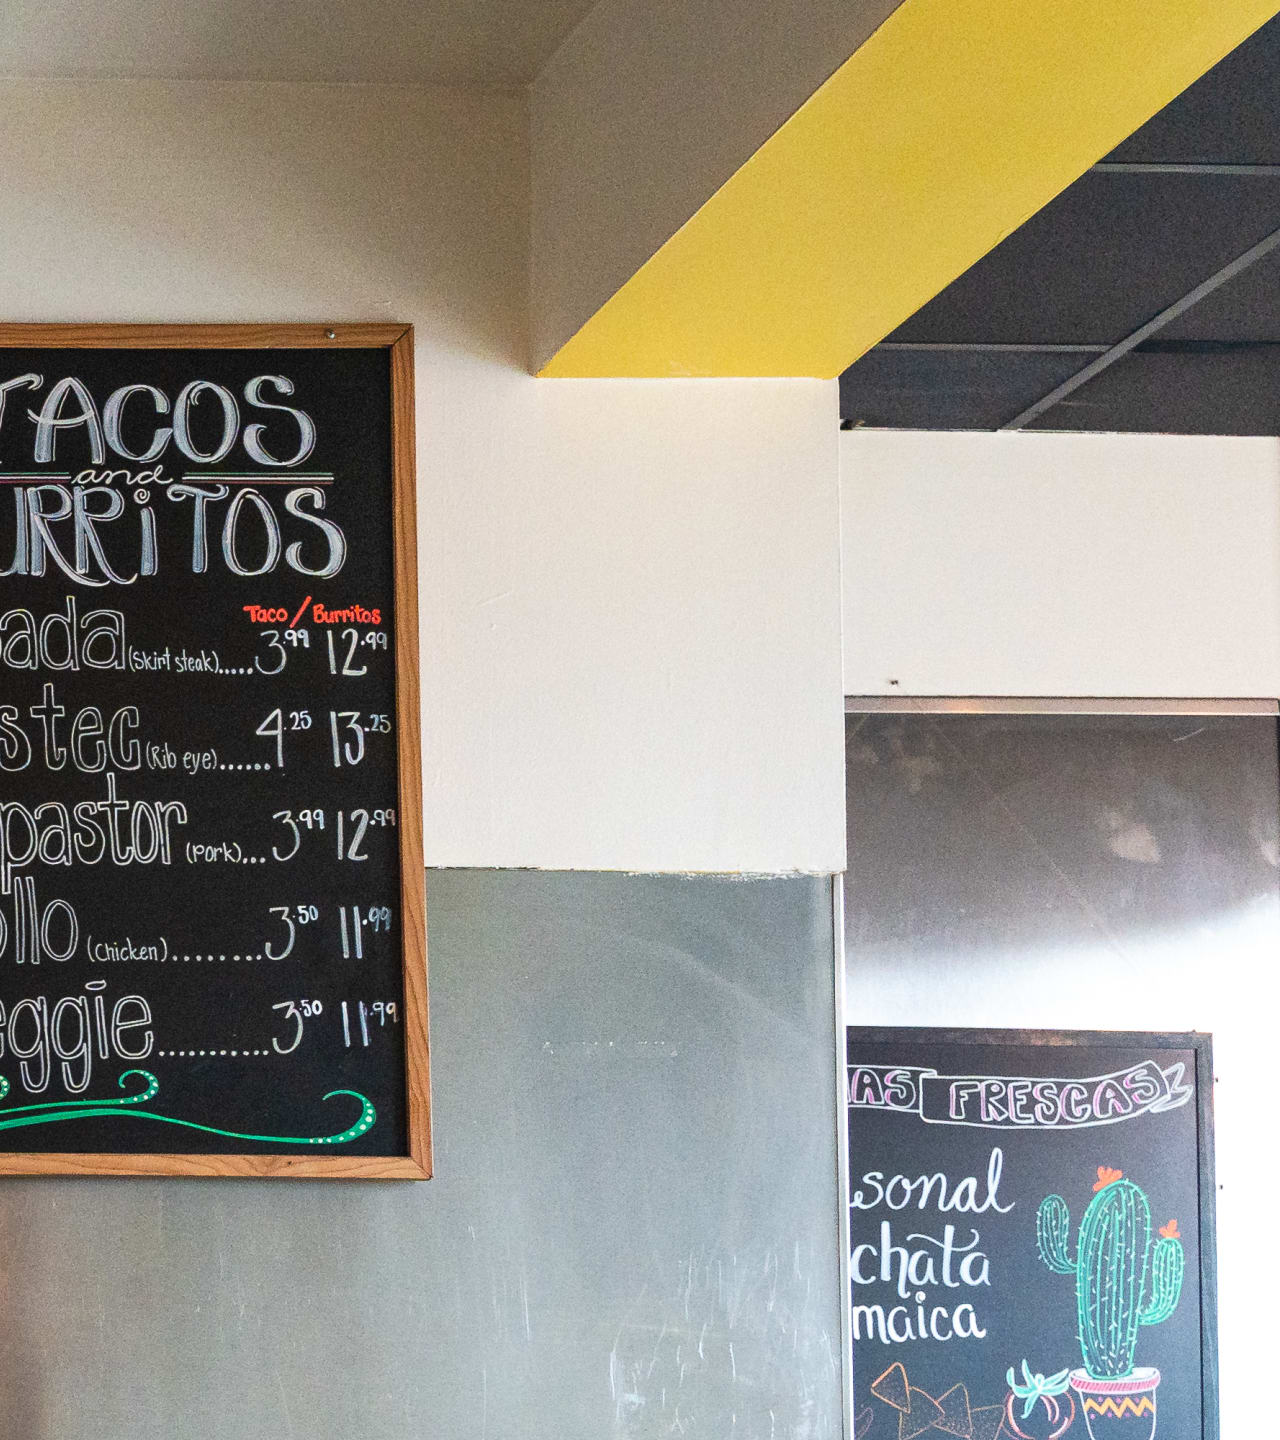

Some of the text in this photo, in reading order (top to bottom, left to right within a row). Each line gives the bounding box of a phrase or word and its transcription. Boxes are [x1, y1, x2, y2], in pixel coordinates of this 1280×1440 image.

[72, 463, 174, 484] and
[147, 741, 176, 769] (Rib
[183, 749, 217, 775] eye)
[0, 773, 187, 894] pastor
[847, 1064, 1162, 1123] AS FRESCAS
[849, 1146, 1015, 1214] sonal
[851, 1221, 991, 1299] chata
[852, 1291, 987, 1345] maica
